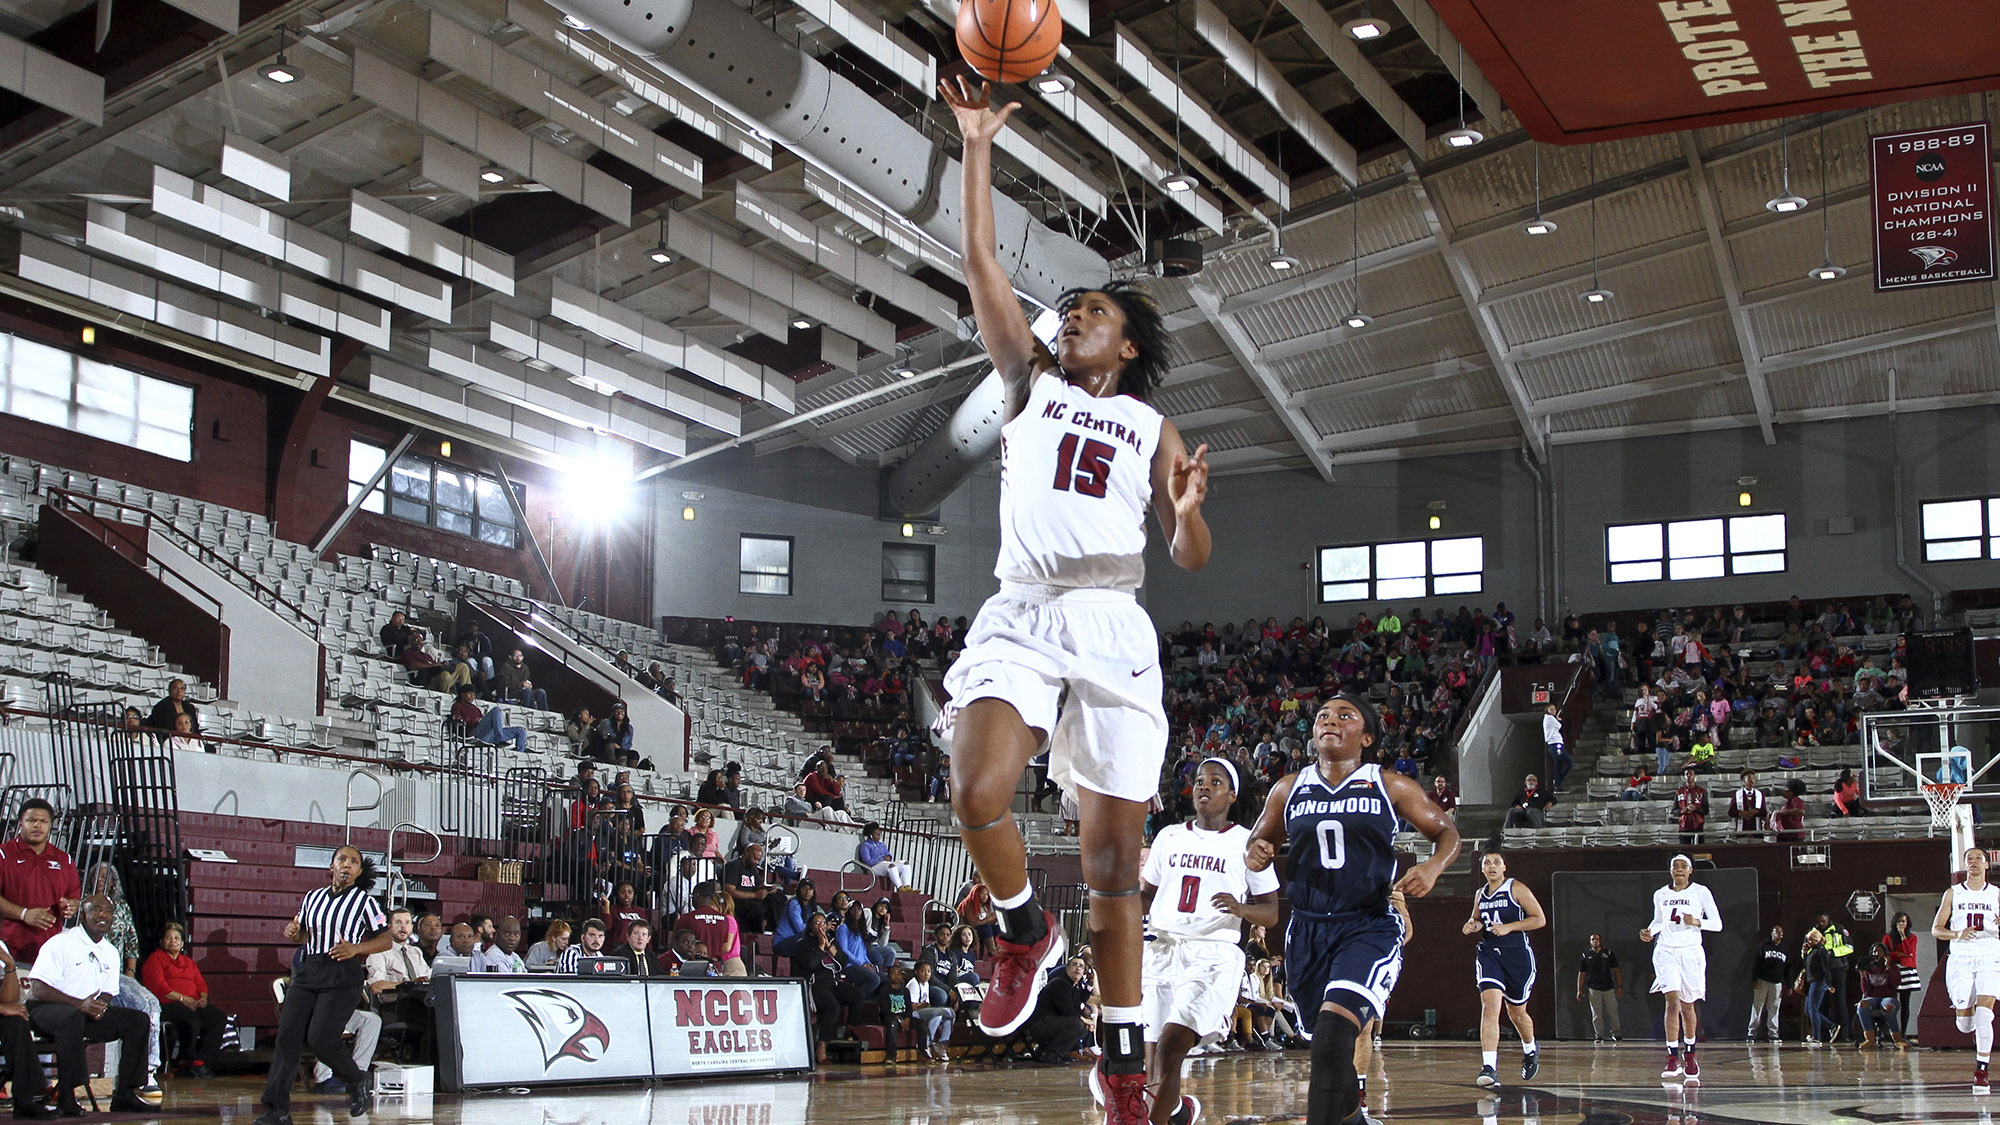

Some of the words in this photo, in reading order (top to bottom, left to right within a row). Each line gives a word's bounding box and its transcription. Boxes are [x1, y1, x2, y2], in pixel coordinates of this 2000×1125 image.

[1791, 30, 1873, 89] THE
[1888, 134, 1975, 154] 1988-89
[1915, 163, 1945, 174] NCAA
[1888, 185, 1960, 201] DIVISION
[1968, 184, 1977, 192] II
[1893, 199, 1974, 215] NATIONAL
[1884, 211, 1983, 230] CHAMPIONS
[1911, 228, 1958, 241] (28-4)
[1885, 275, 1917, 283] MEN'S
[1921, 268, 1986, 280] BASKETBALL
[1042, 400, 1067, 420] NC
[1071, 411, 1142, 456] CENTRAL
[1053, 432, 1117, 499] 15
[1532, 682, 1554, 693] 7-8
[1290, 797, 1381, 820] LONGWOOD
[1316, 819, 1345, 870] 0
[1180, 853, 1226, 874] CENTRAL
[1177, 875, 1201, 913] 0
[1670, 908, 1681, 924] 4
[1967, 902, 1992, 911] CENTRAL
[1967, 913, 1984, 931] 10
[674, 989, 778, 1027] NCCU
[688, 1029, 773, 1054] EAGLES
